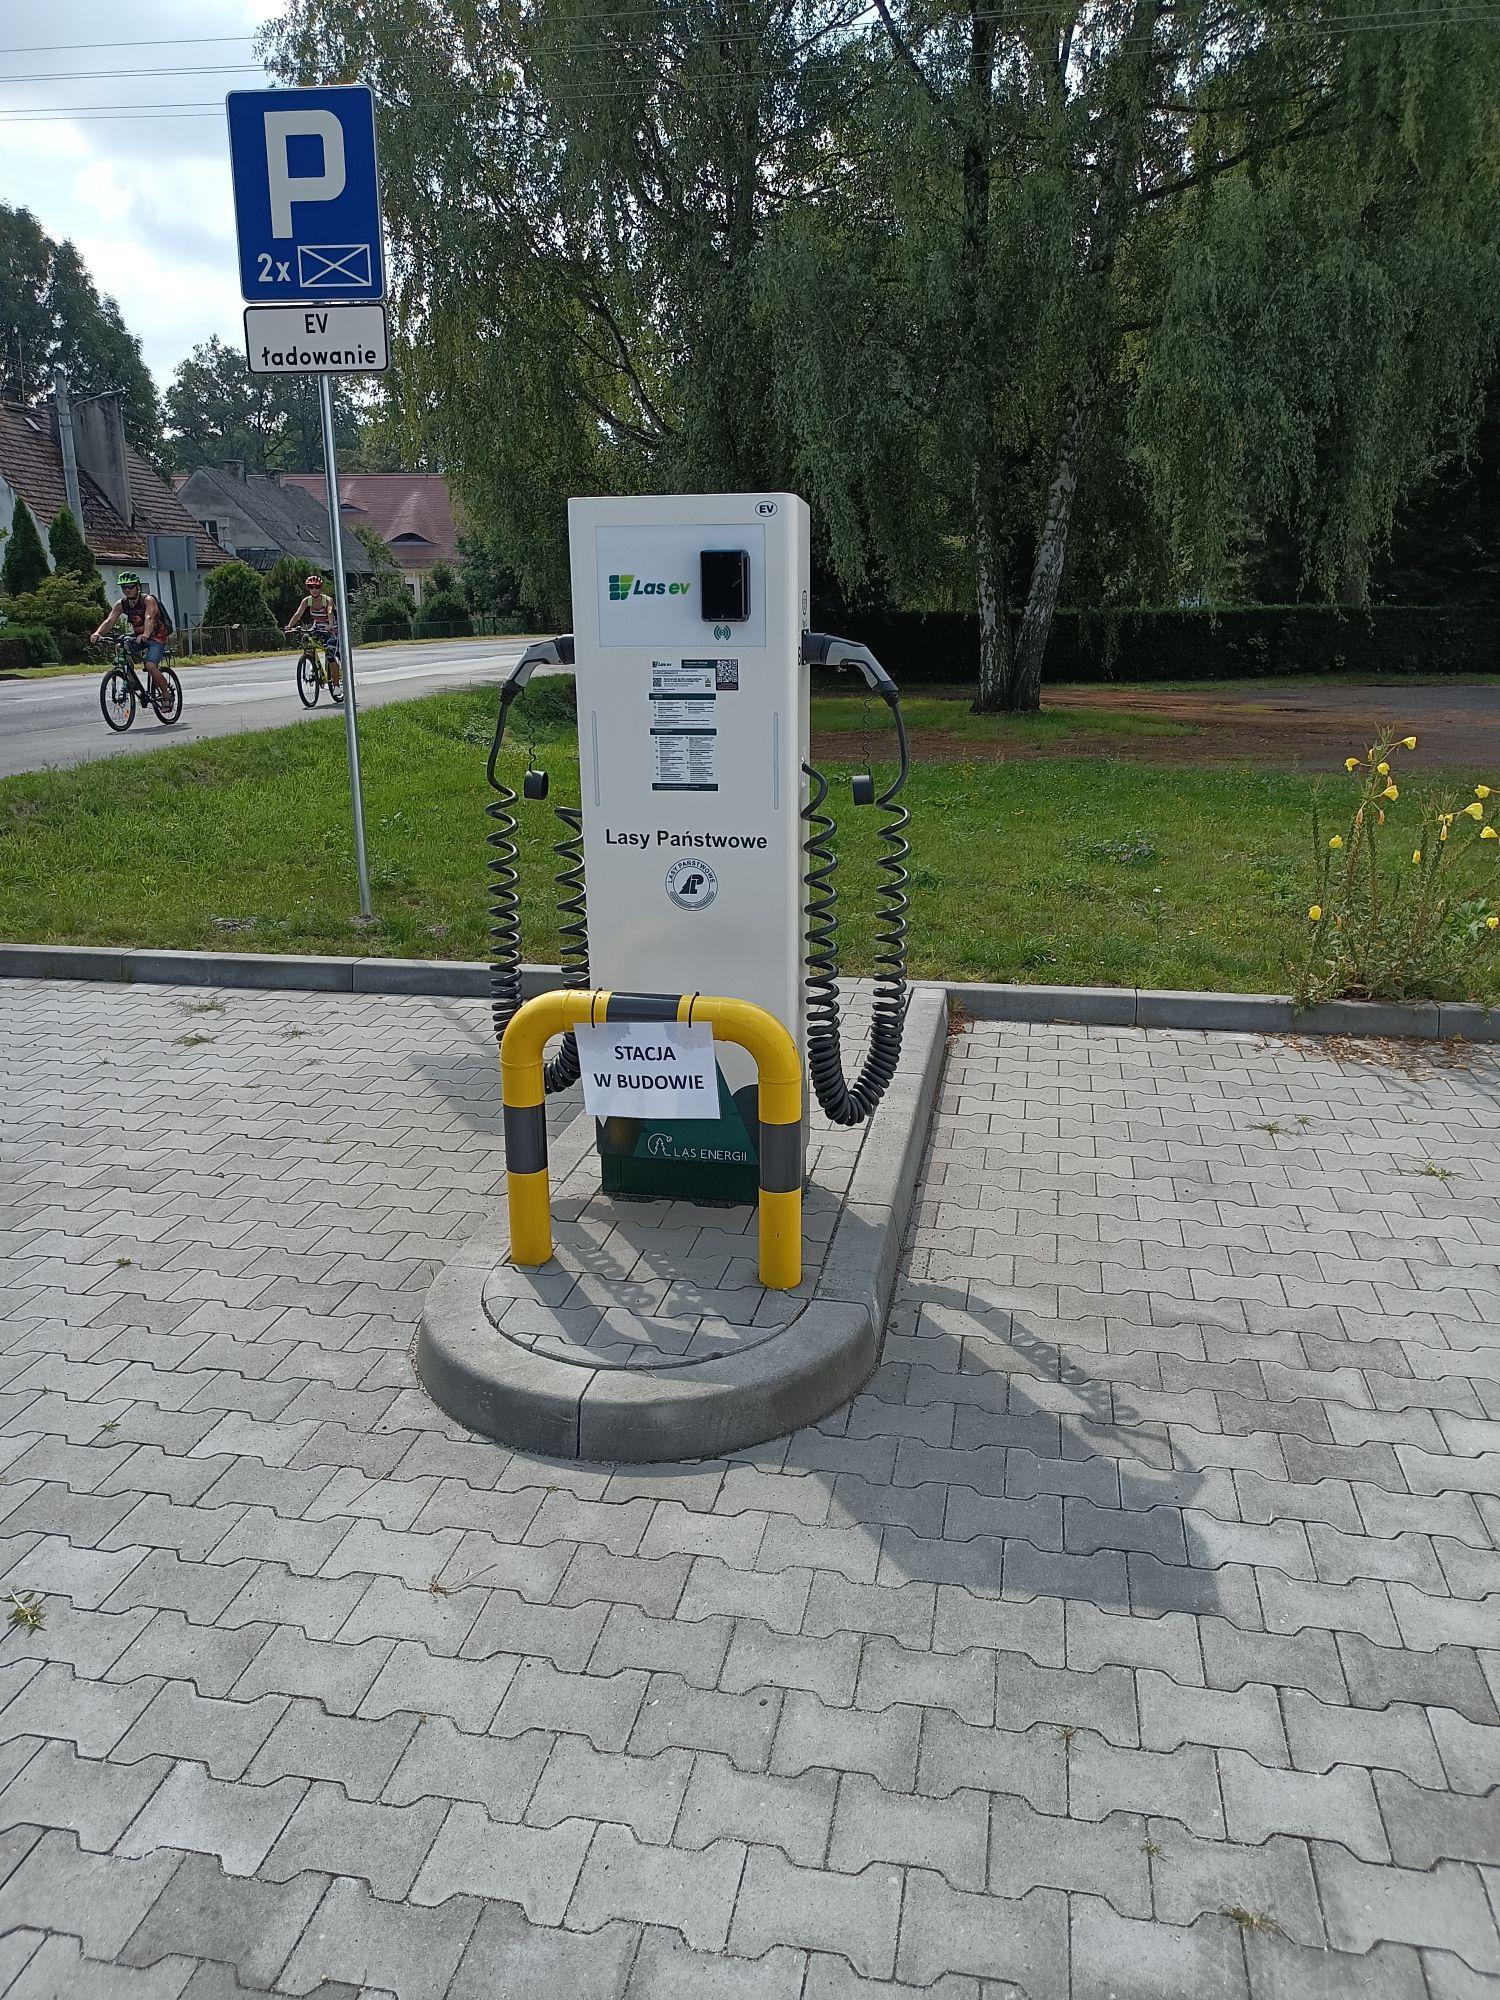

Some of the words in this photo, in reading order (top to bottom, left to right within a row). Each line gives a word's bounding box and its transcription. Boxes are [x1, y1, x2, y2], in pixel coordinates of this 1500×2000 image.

[264, 110, 346, 239] P
[257, 253, 291, 282] 2x
[305, 313, 328, 334] EV
[262, 344, 376, 366] ładowanie
[759, 504, 774, 514] EV
[633, 579, 666, 595] Las
[668, 582, 692, 595] ev
[606, 828, 650, 850] Lasy
[657, 830, 768, 849] Państwowe
[668, 866, 678, 883] LASY
[614, 1045, 677, 1061] STACJA
[593, 1073, 612, 1088] W
[617, 1074, 704, 1090] BUDOWIE
[674, 1148, 697, 1158] LAS
[700, 1149, 747, 1162] ENERGII
